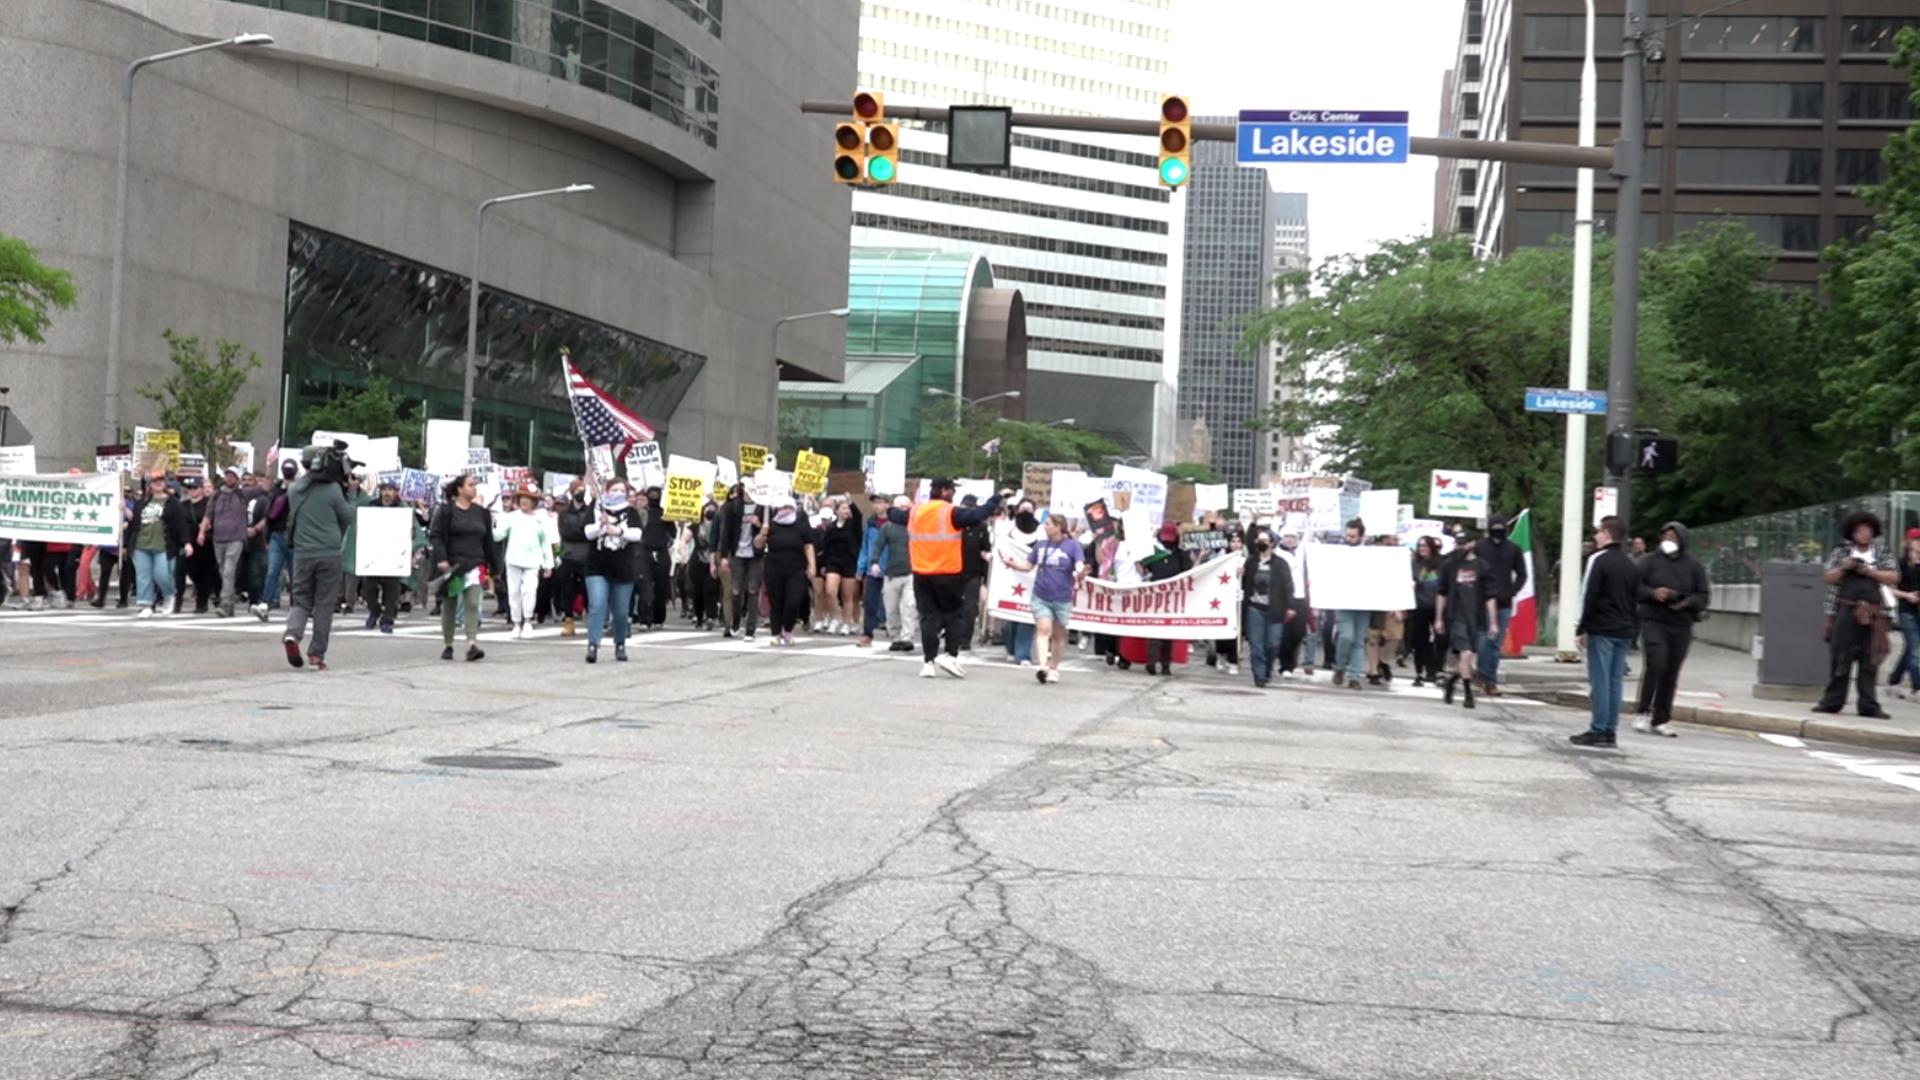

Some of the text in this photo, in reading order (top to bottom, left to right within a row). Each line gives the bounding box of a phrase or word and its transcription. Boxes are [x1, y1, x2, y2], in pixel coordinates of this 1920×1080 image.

[1289, 110, 1360, 122] Civic Center
[1252, 127, 1395, 157] Lakeside
[1535, 396, 1596, 410] Lakeside
[627, 444, 657, 459] STOP
[741, 446, 766, 458] STOP
[22, 480, 61, 489] UNITED
[63, 481, 86, 490] WILL
[669, 476, 702, 491] STOP
[6, 489, 114, 506] IMMIGRANT
[671, 498, 696, 508] BLACK
[667, 506, 699, 516] AMERICA
[1086, 586, 1114, 612] THE
[1121, 592, 1187, 614] PUPPET!
